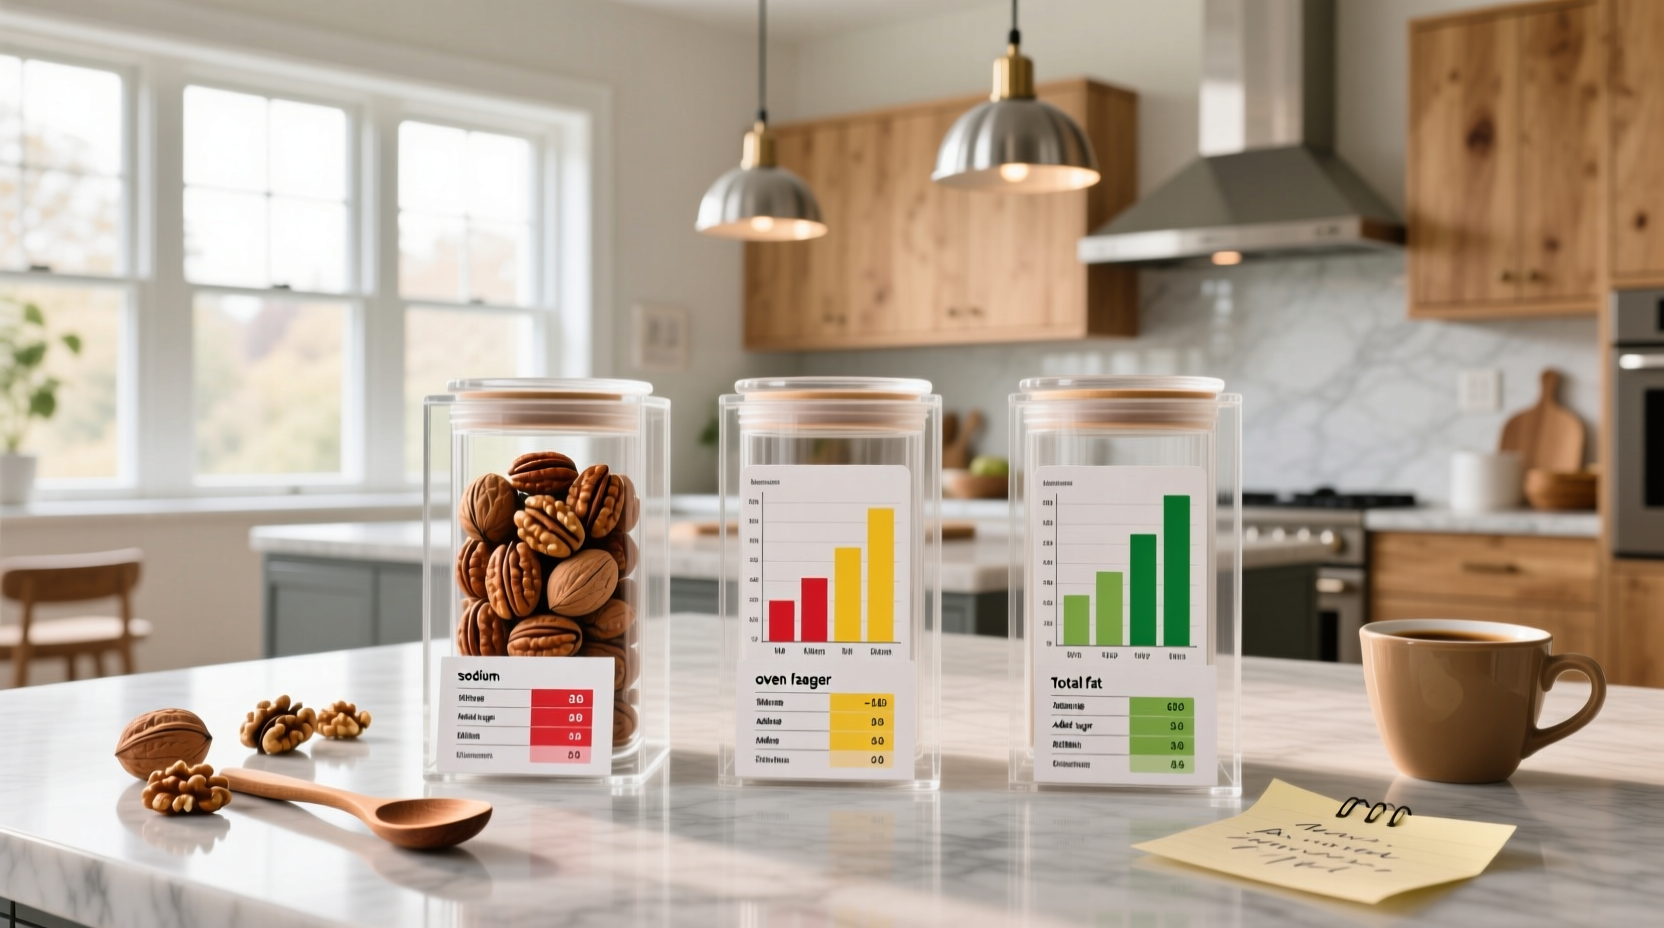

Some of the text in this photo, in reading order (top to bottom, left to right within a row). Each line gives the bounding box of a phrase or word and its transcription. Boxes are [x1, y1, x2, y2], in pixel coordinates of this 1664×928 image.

[458, 670, 500, 682] sodium
[755, 675, 786, 686] oven
[1051, 676, 1103, 689] Total fat
